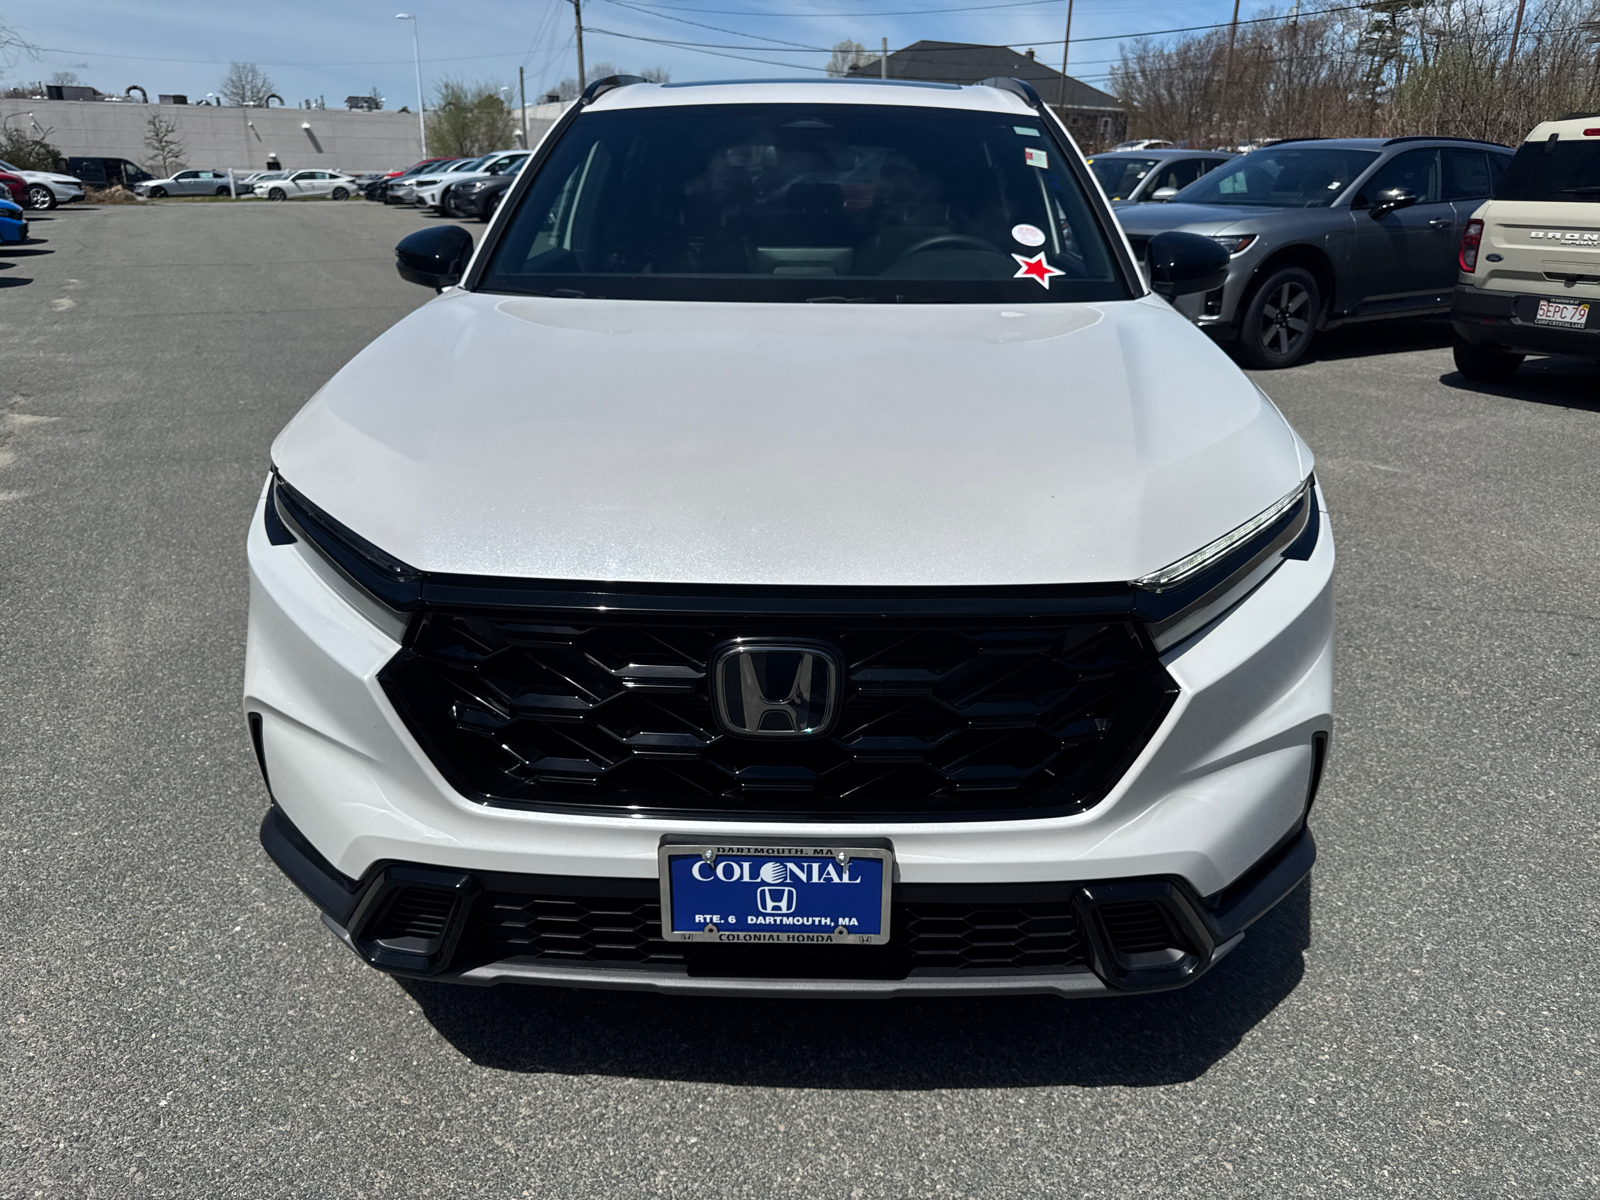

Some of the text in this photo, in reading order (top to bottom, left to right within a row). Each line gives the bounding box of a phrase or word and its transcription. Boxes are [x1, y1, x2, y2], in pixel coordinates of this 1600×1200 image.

[1538, 304, 1586, 321] 5EPC 79
[691, 861, 862, 884] COLONIAL
[695, 914, 859, 928] RTE. 6 DARTMOUTH, MA
[719, 934, 834, 944] COLONIAL HONDA
